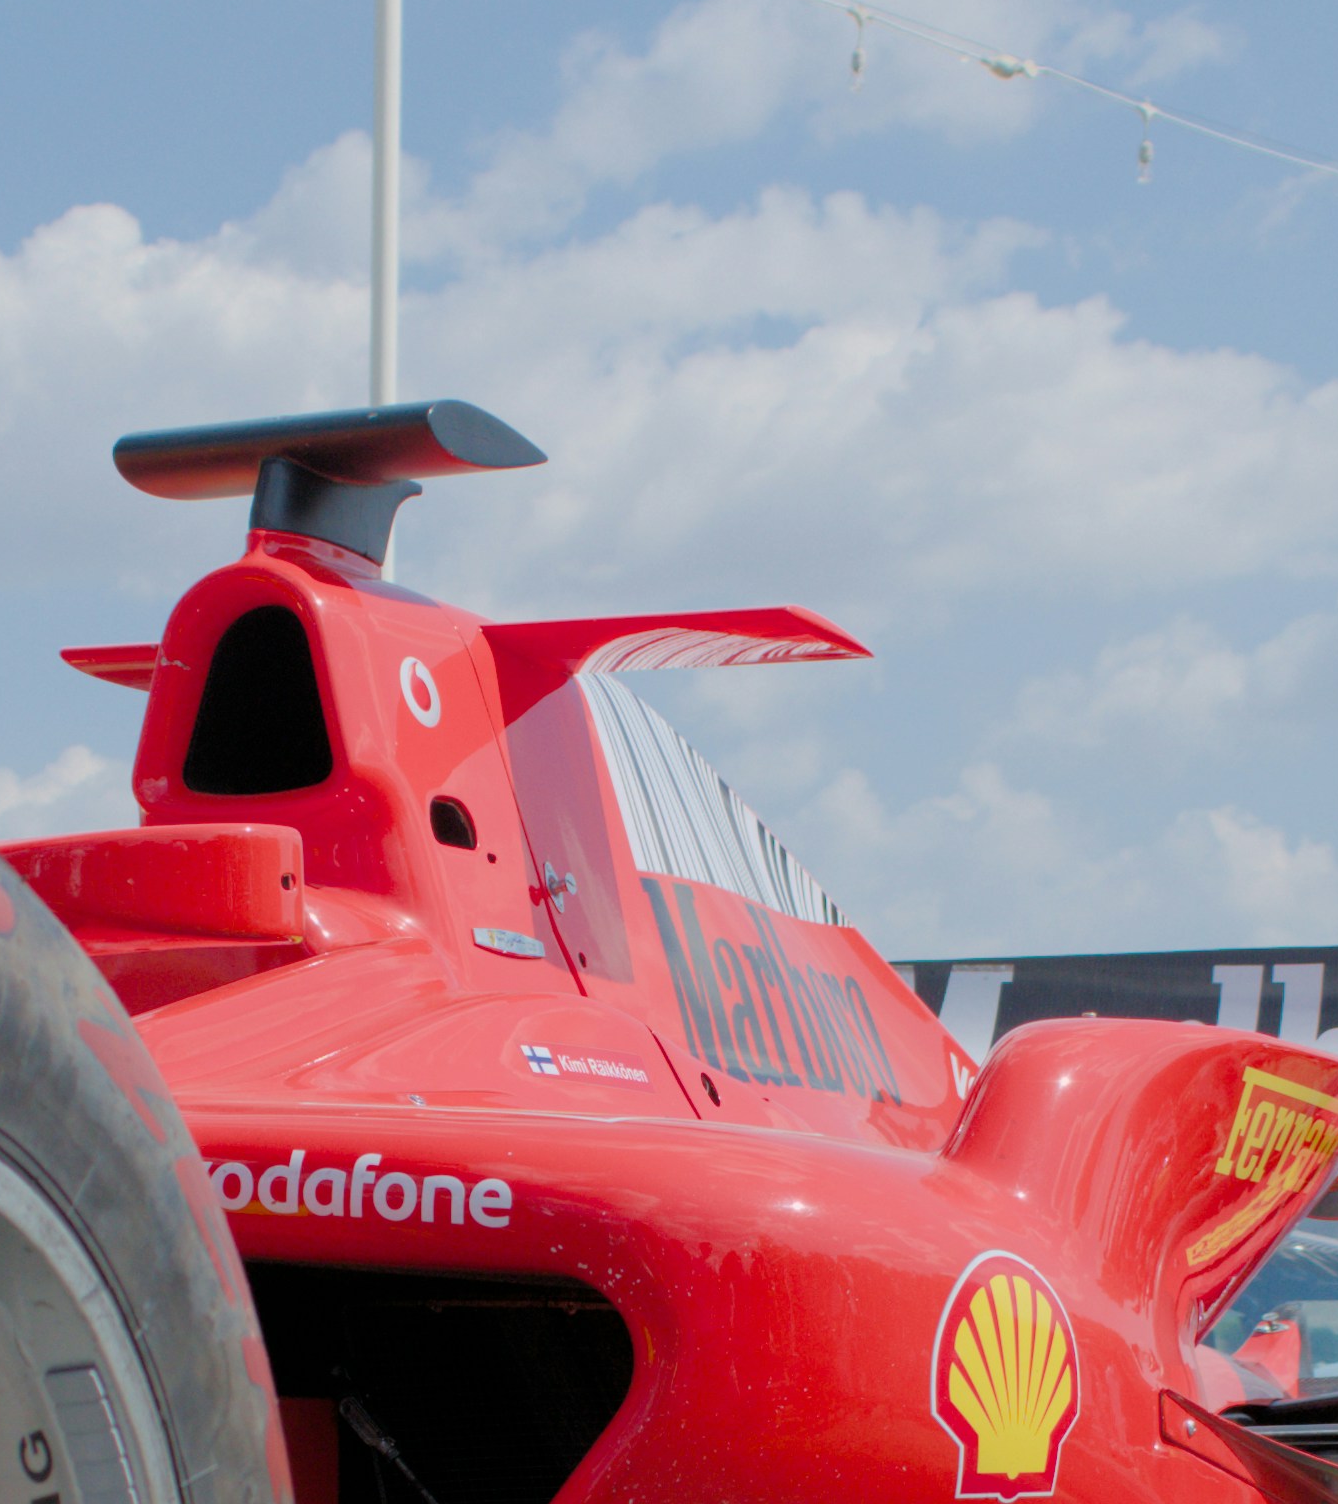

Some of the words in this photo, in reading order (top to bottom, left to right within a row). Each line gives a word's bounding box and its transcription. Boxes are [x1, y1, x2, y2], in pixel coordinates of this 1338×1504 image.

[639, 875, 903, 1108] Marlboro
[557, 1054, 590, 1075] Kimi
[202, 1148, 513, 1229] odafone
